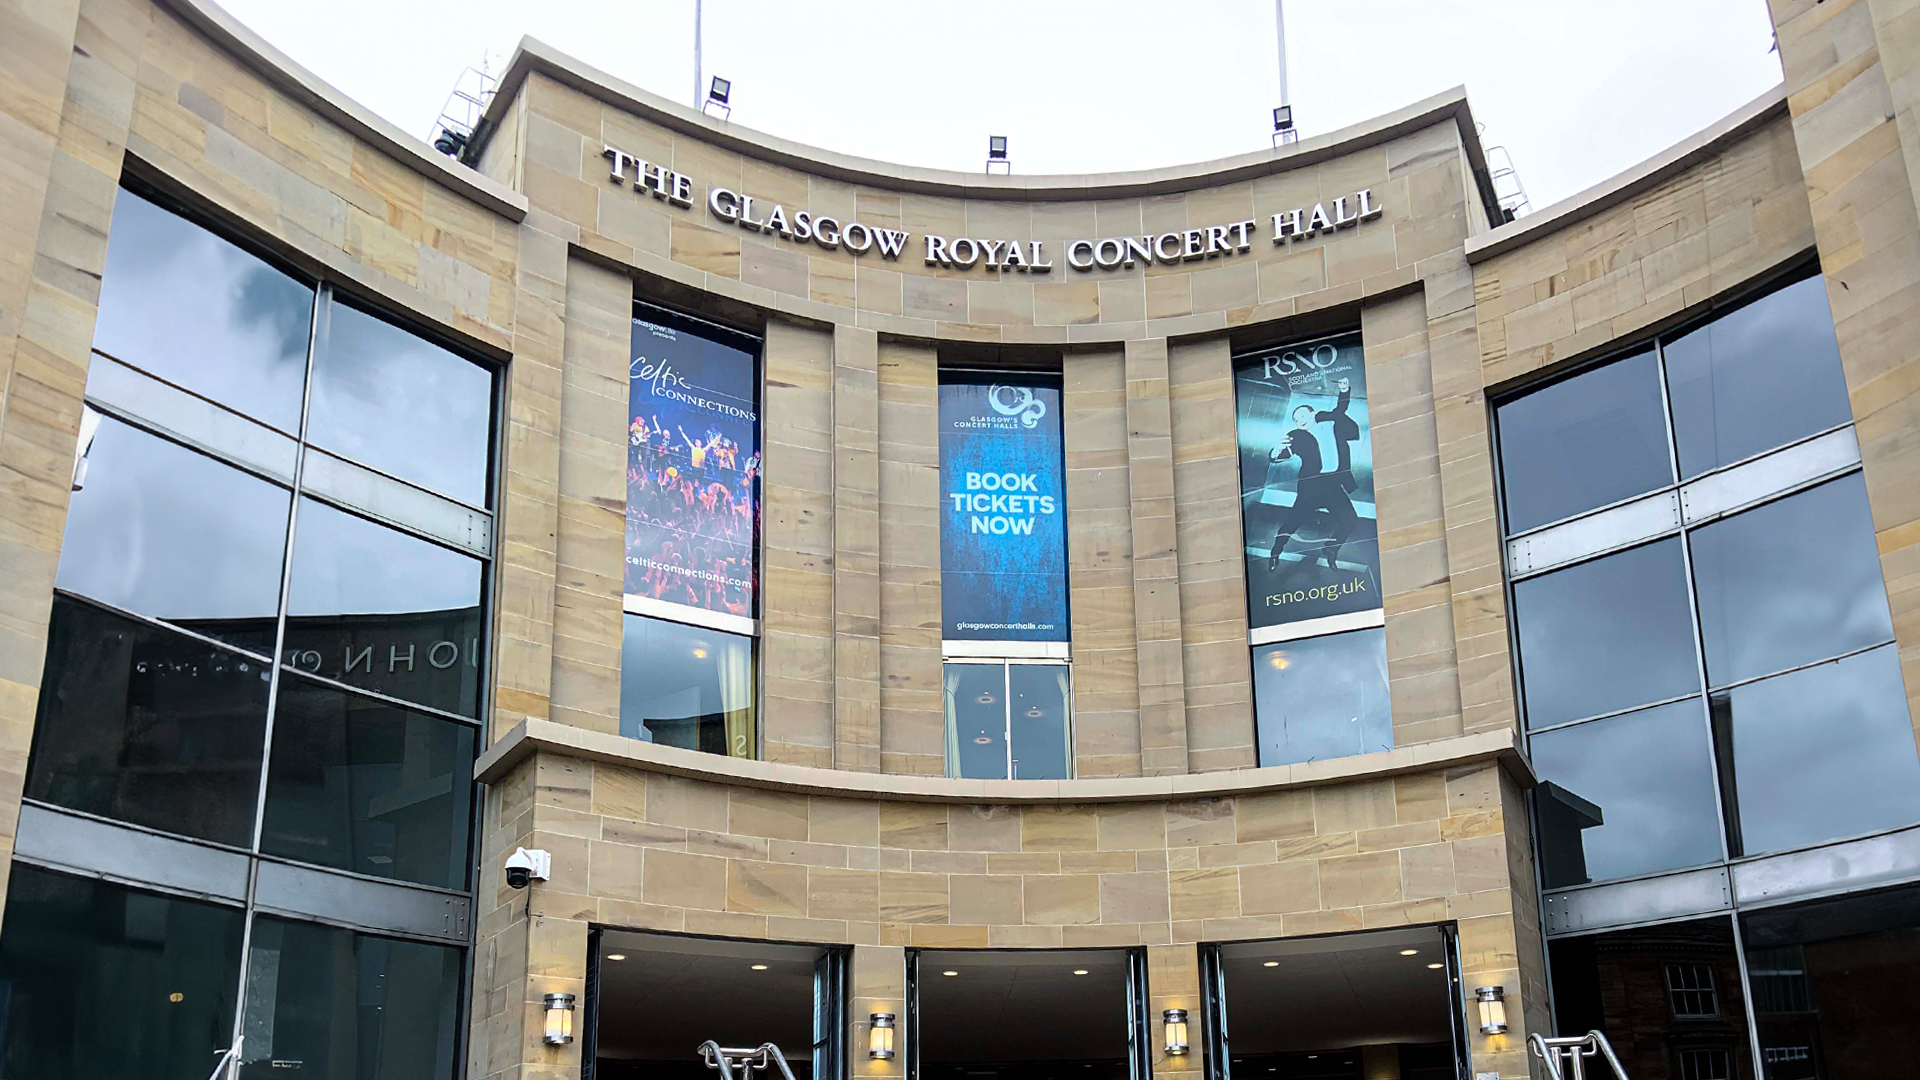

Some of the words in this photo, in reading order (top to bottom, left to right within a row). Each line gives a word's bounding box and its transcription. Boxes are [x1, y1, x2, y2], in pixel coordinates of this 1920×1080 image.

[603, 145, 694, 209] THE
[709, 187, 909, 260] GLASGOW
[924, 235, 1052, 272] ROYAL
[1067, 218, 1256, 271] CONCERT
[1271, 188, 1382, 246] HALL
[629, 356, 691, 396] Celtic
[1262, 344, 1338, 380] RSNO
[656, 387, 757, 422] CONNECTIONS
[953, 421, 991, 429] CONCERT
[993, 422, 1018, 430] HALLS
[966, 472, 1038, 492] BOOK
[950, 493, 1055, 514] TICKETS
[971, 515, 1035, 535] NOW
[625, 555, 751, 588] celticconnections.com
[1266, 577, 1366, 606] rsno.org.uk
[956, 621, 1054, 631] glasgowconcerthalls.com
